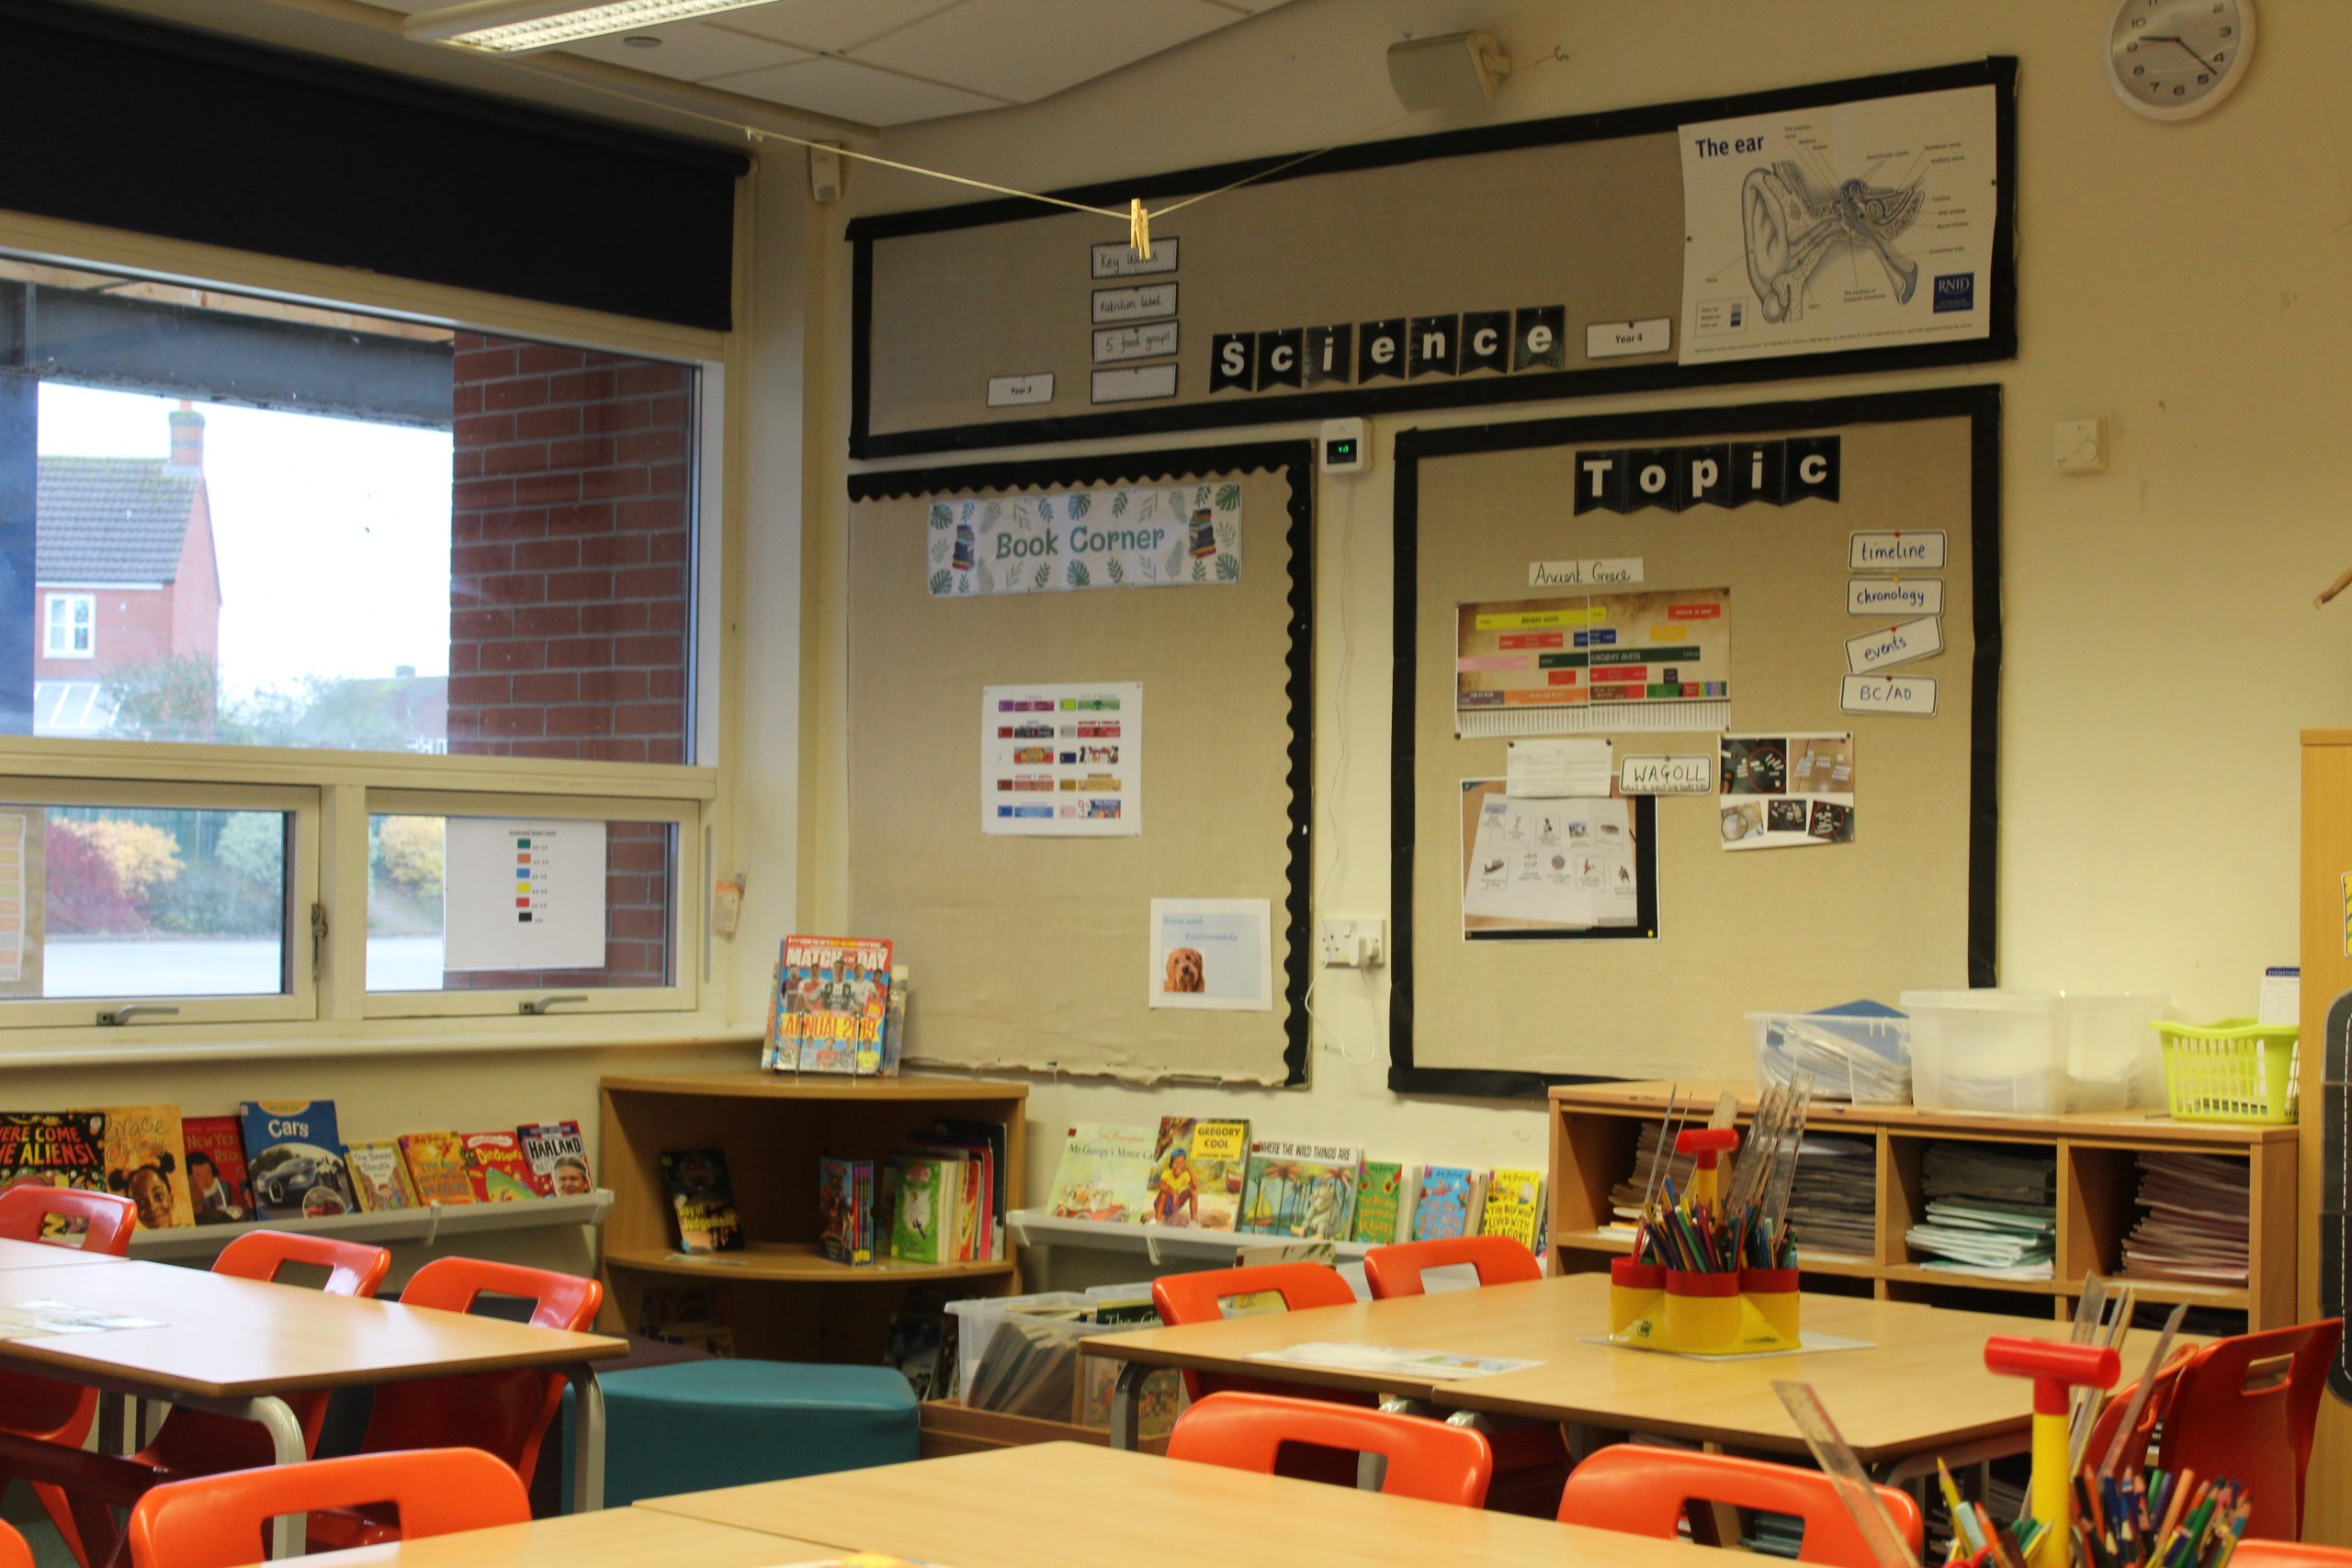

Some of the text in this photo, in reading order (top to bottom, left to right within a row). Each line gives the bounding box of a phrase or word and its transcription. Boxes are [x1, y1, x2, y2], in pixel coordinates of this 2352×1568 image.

[2213, 52, 2224, 62] 4
[2150, 82, 2160, 92] 7
[1695, 134, 1765, 158] The ear
[1101, 253, 1119, 273] Key
[1938, 276, 1970, 294] RNID
[1141, 294, 1162, 307] label
[1106, 332, 1170, 354] 5 food groups
[1614, 333, 1643, 345] Year 4
[1221, 325, 1553, 377] Science
[1011, 387, 1025, 395] Year
[1583, 451, 1827, 498] Topic
[995, 525, 1164, 560] Book Corner
[1861, 541, 1925, 561] timeline
[1534, 561, 1632, 585] Ancient Greece
[1857, 586, 1925, 606] chronology
[1863, 636, 1906, 661] events
[1860, 684, 1912, 702] BC/AD
[1634, 764, 1705, 784] WAGOLL
[786, 946, 842, 967] MATCH
[857, 948, 888, 970] DAY
[35, 1126, 81, 1143] COME
[267, 1118, 310, 1139] Cars
[1197, 1126, 1241, 1137] GREGORY
[1069, 1144, 1080, 1155] Mr
[1116, 1147, 1141, 1159] Motor
[1142, 1149, 1153, 1159] Ca
[1204, 1138, 1228, 1148] COOL
[1259, 1141, 1351, 1161] WHERE THE WILD THINGS ARE
[18, 1142, 98, 1166] ALIENS!
[475, 1147, 523, 1166] Dinosaurs
[677, 1204, 694, 1217] Day
[1490, 1204, 1532, 1218] THE BOY WHO
[684, 1215, 736, 1231] Judgement
[1488, 1217, 1530, 1229] LIVED WITH
[1487, 1228, 1529, 1244] DRAGONS
